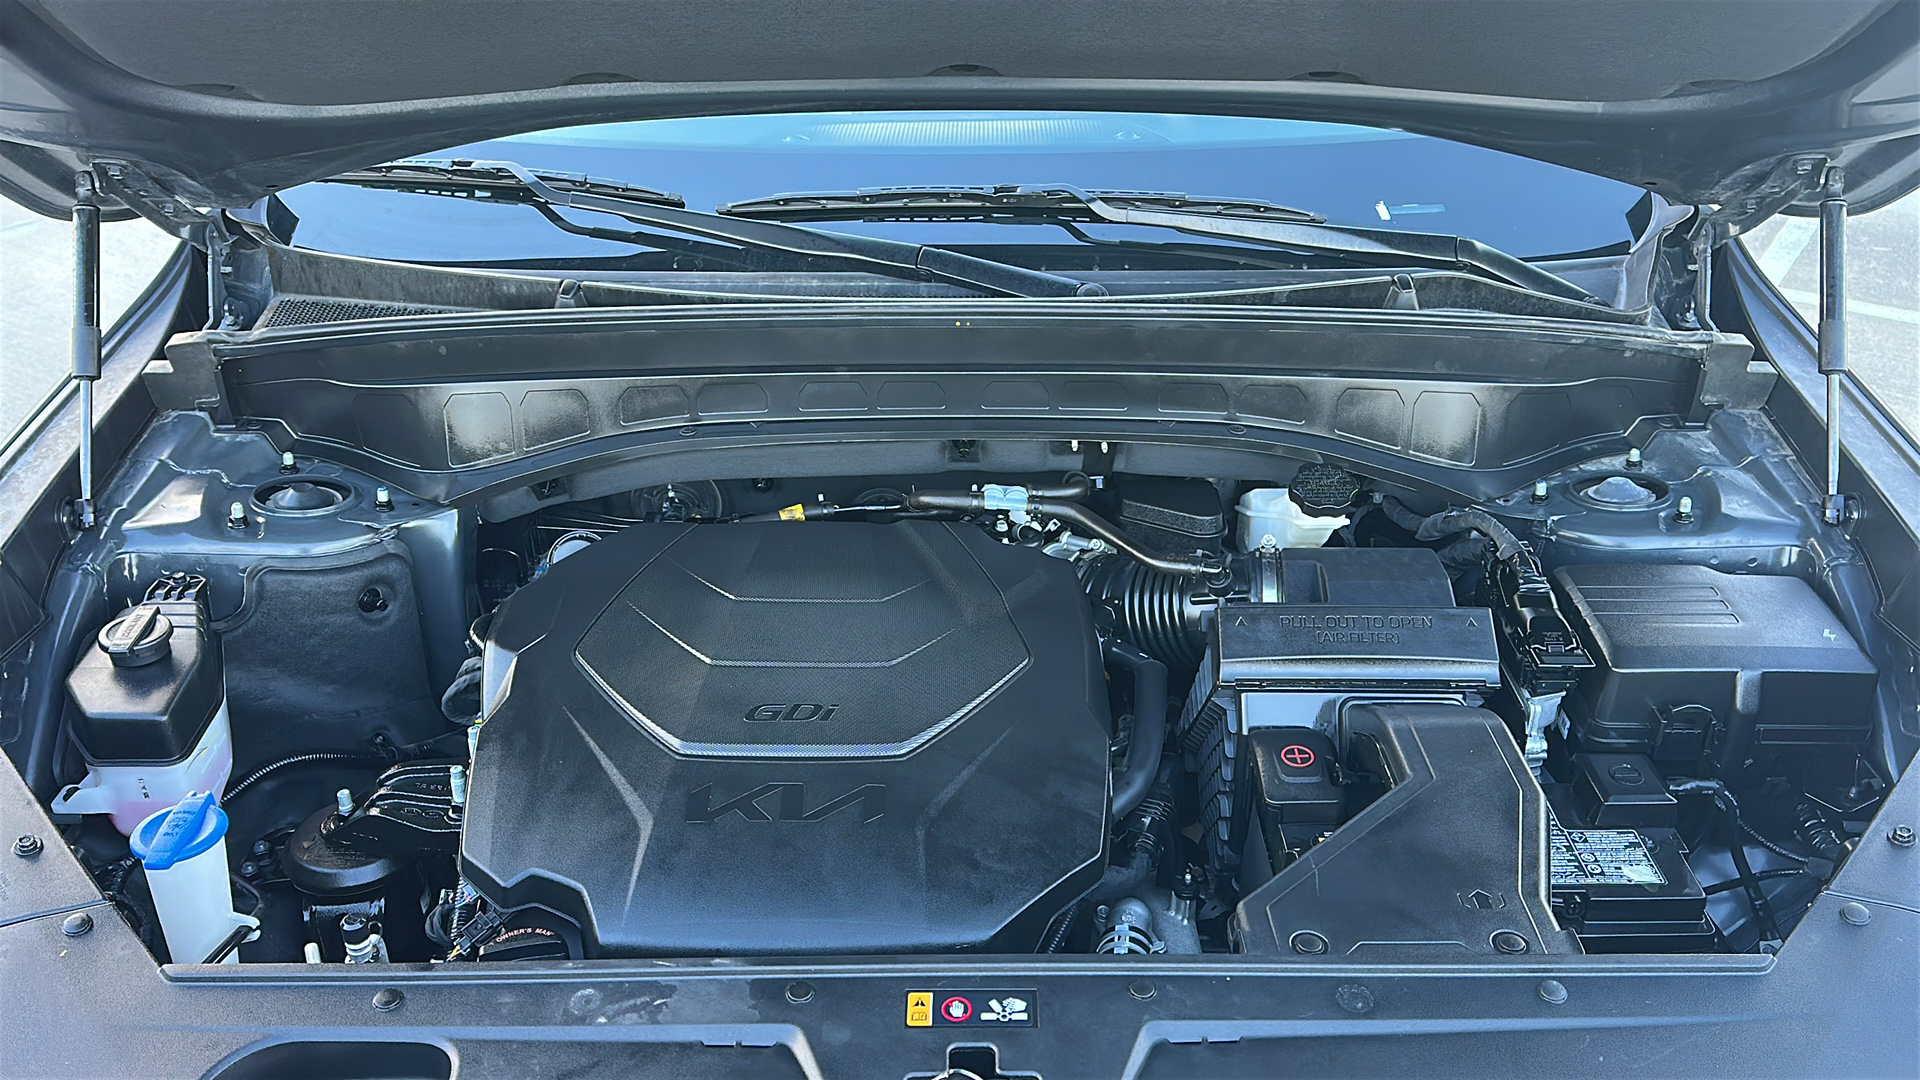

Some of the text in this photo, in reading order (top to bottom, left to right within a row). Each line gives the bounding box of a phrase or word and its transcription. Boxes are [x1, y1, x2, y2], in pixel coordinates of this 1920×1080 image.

[1279, 615, 1433, 629] PULL OUT TO OPEN
[744, 703, 840, 722] GDi
[495, 927, 532, 943] OWNER'S
